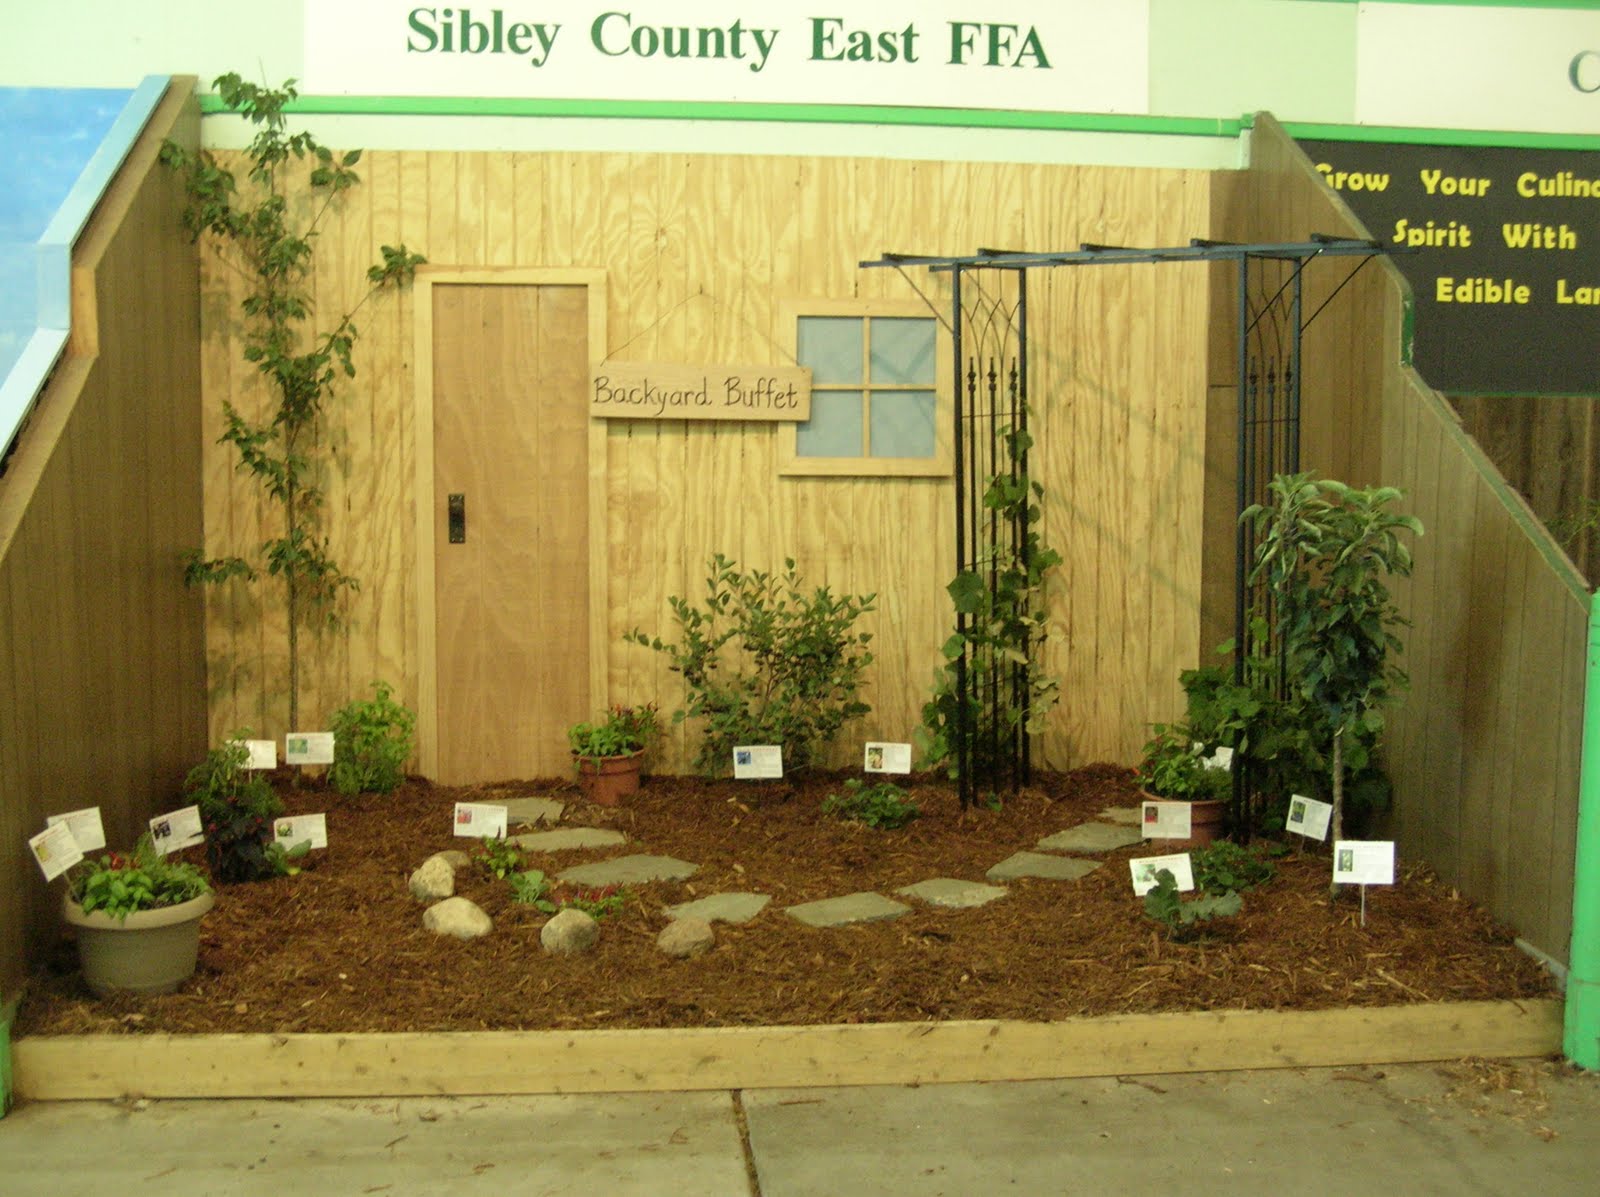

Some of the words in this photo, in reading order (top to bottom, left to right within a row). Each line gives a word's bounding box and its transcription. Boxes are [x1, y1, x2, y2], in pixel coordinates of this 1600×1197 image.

[407, 7, 562, 67] Sibley
[590, 11, 780, 72] County
[807, 17, 920, 63] East
[945, 21, 1053, 69] FFA
[1420, 169, 1491, 197] Your
[1392, 219, 1472, 248] Spirit
[1502, 223, 1577, 250] With
[1436, 277, 1531, 304] Edible
[593, 375, 713, 416] Backyard
[723, 376, 798, 409] Buffet
